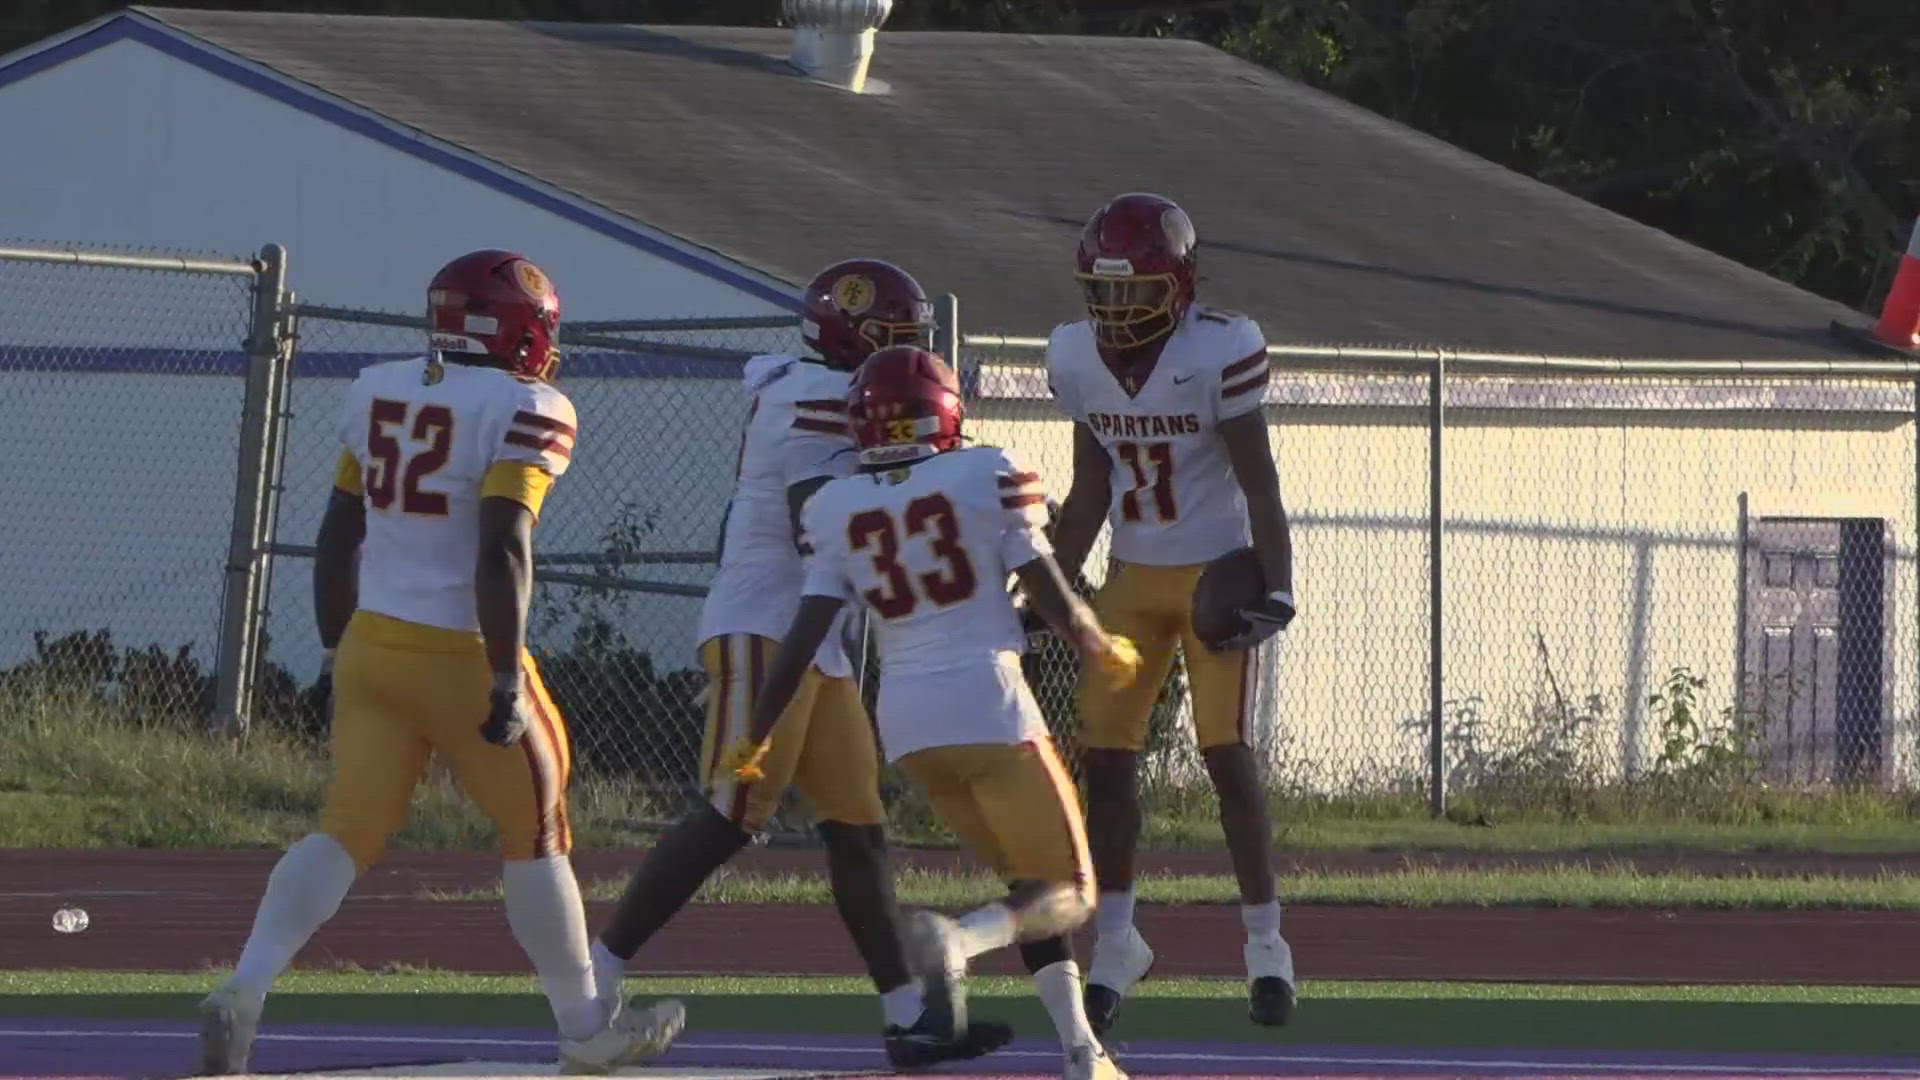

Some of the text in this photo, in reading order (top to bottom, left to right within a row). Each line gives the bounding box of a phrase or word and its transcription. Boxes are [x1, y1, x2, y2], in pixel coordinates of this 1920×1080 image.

[366, 397, 455, 515] 52
[886, 420, 916, 441] 33
[1088, 412, 1200, 437] SPARTANS
[1116, 440, 1178, 524] 11
[848, 491, 977, 621] 33
